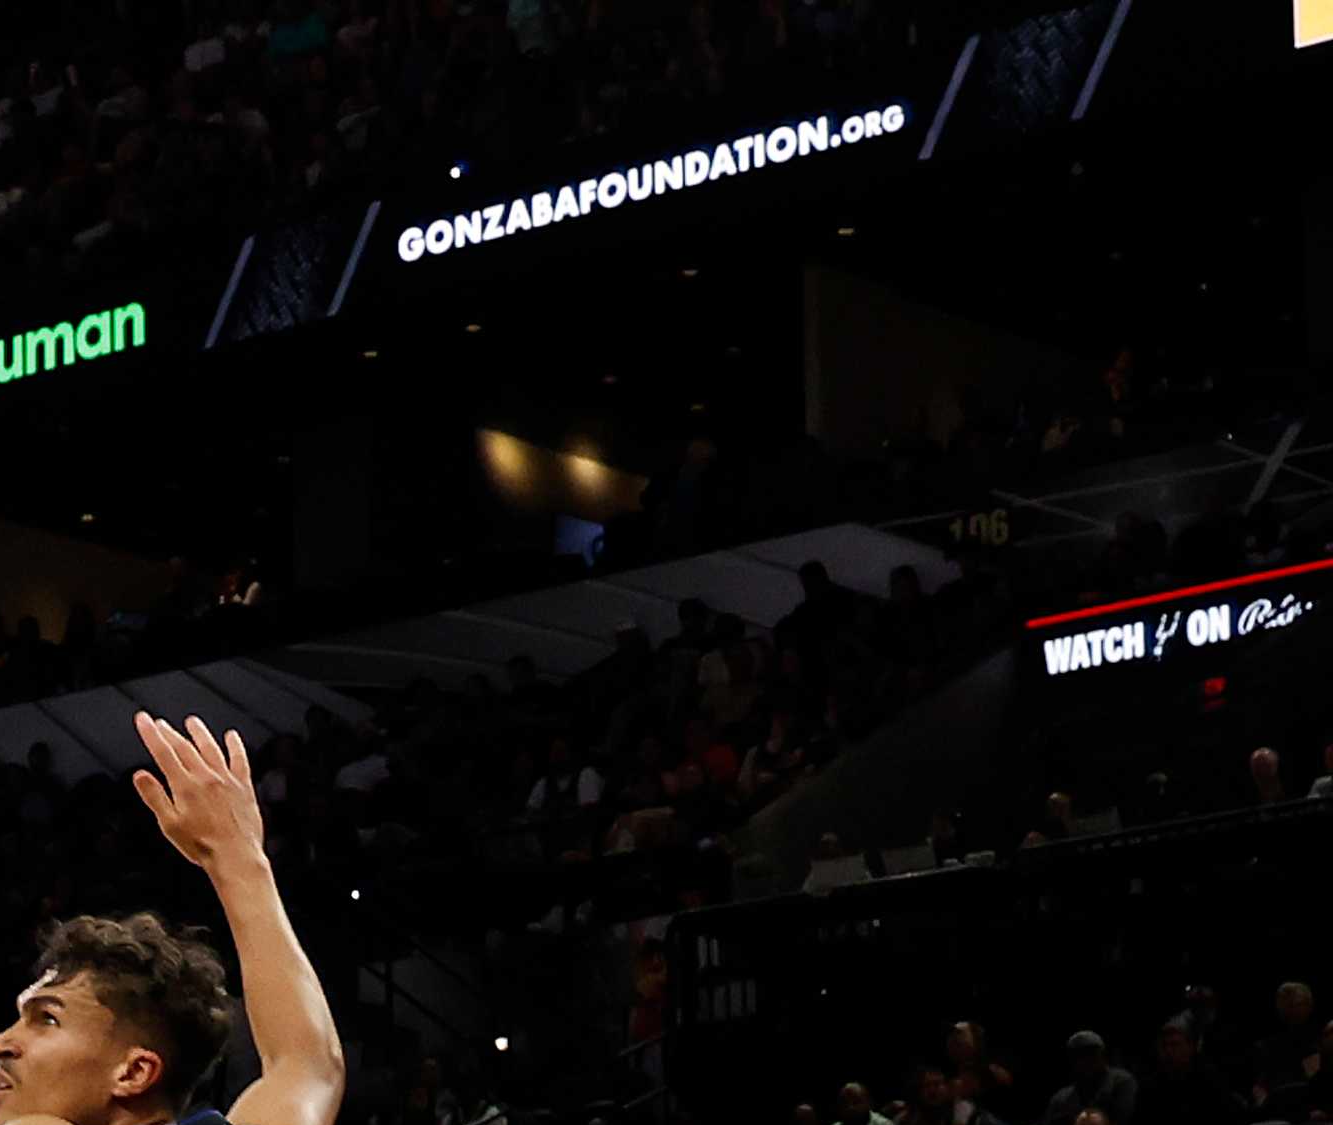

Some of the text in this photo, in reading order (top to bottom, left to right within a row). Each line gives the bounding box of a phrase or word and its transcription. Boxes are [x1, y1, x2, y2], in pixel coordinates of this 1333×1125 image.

[397, 104, 905, 262] GONZABAFOUNDATION.ORG
[1044, 621, 1145, 675] WATCH
[1187, 604, 1230, 646] ON
